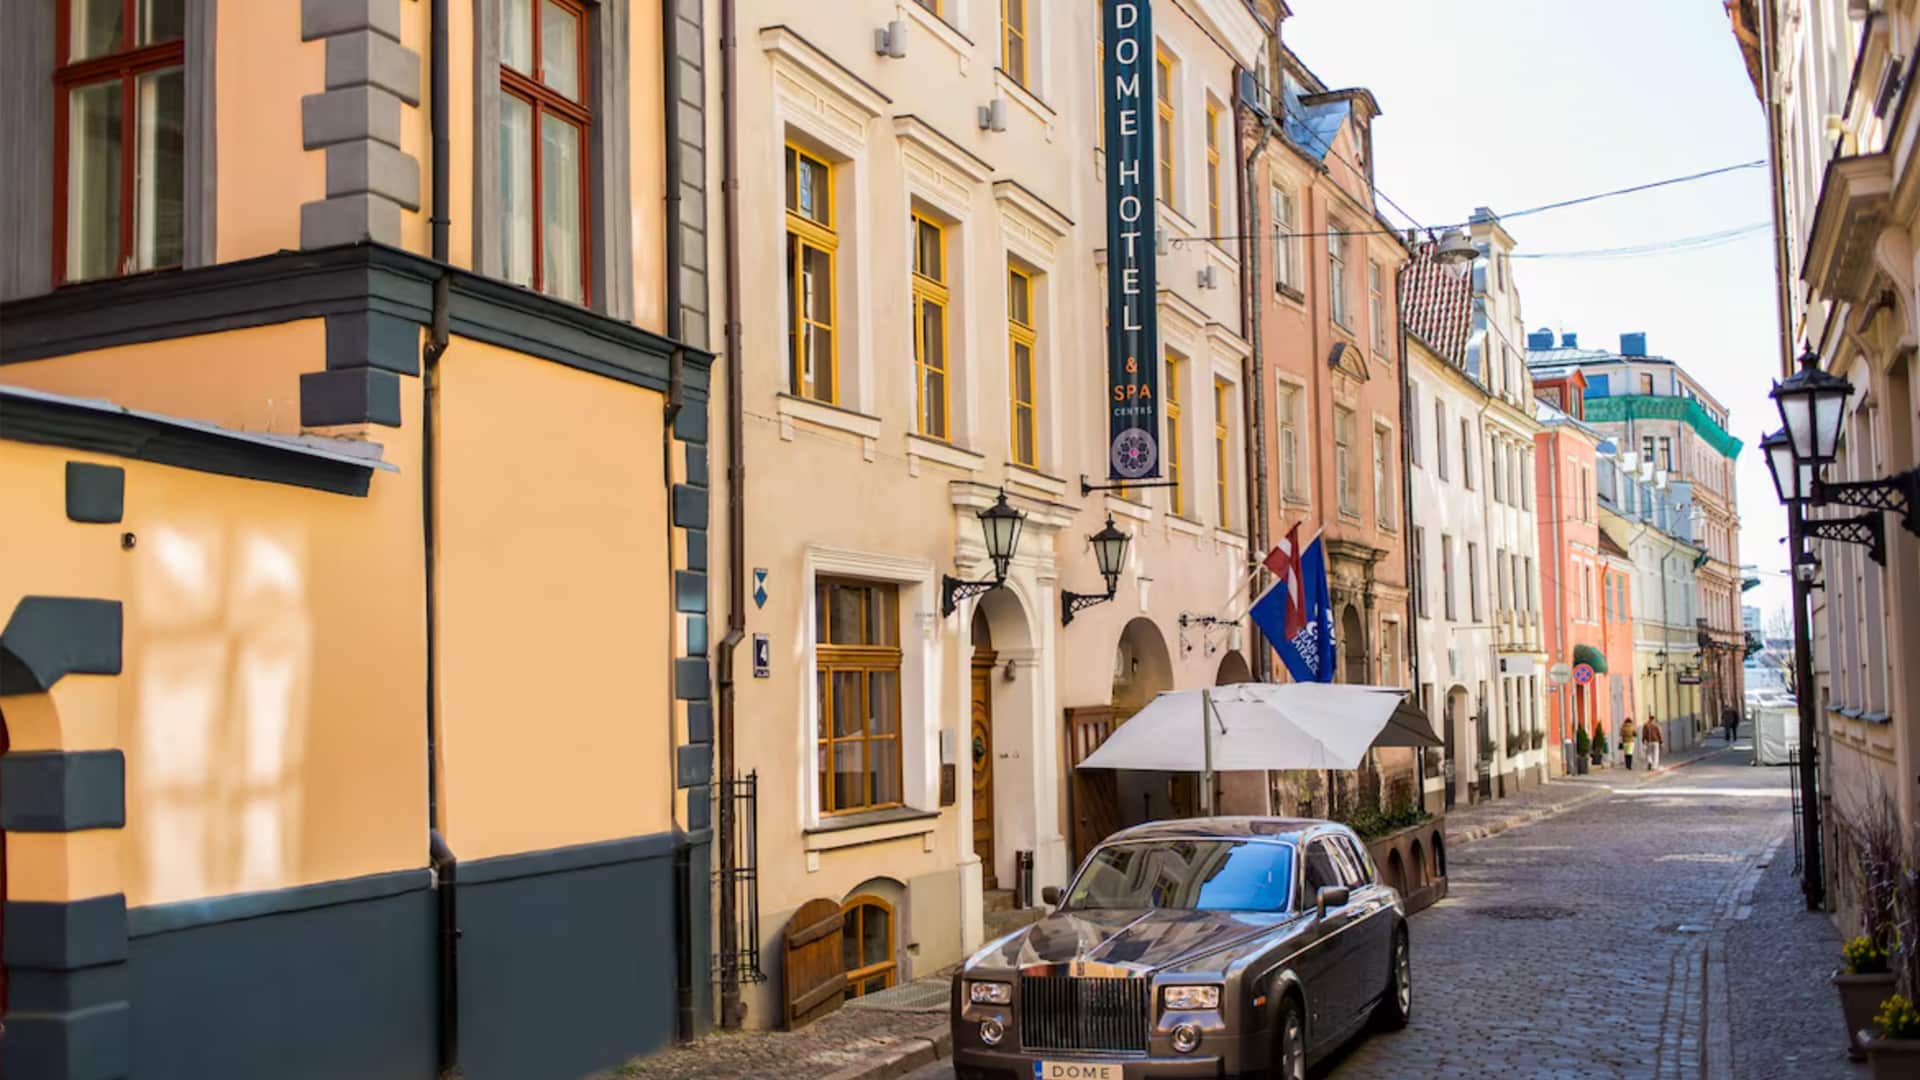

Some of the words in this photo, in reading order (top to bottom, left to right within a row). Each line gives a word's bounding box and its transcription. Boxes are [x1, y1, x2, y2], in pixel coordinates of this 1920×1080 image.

[1115, 3, 1140, 135] DOME
[1119, 160, 1142, 330] HOTEL
[1125, 356, 1138, 373] &
[1114, 384, 1152, 401] SPA
[760, 643, 768, 662] 4
[1052, 1065, 1110, 1079] DOME
